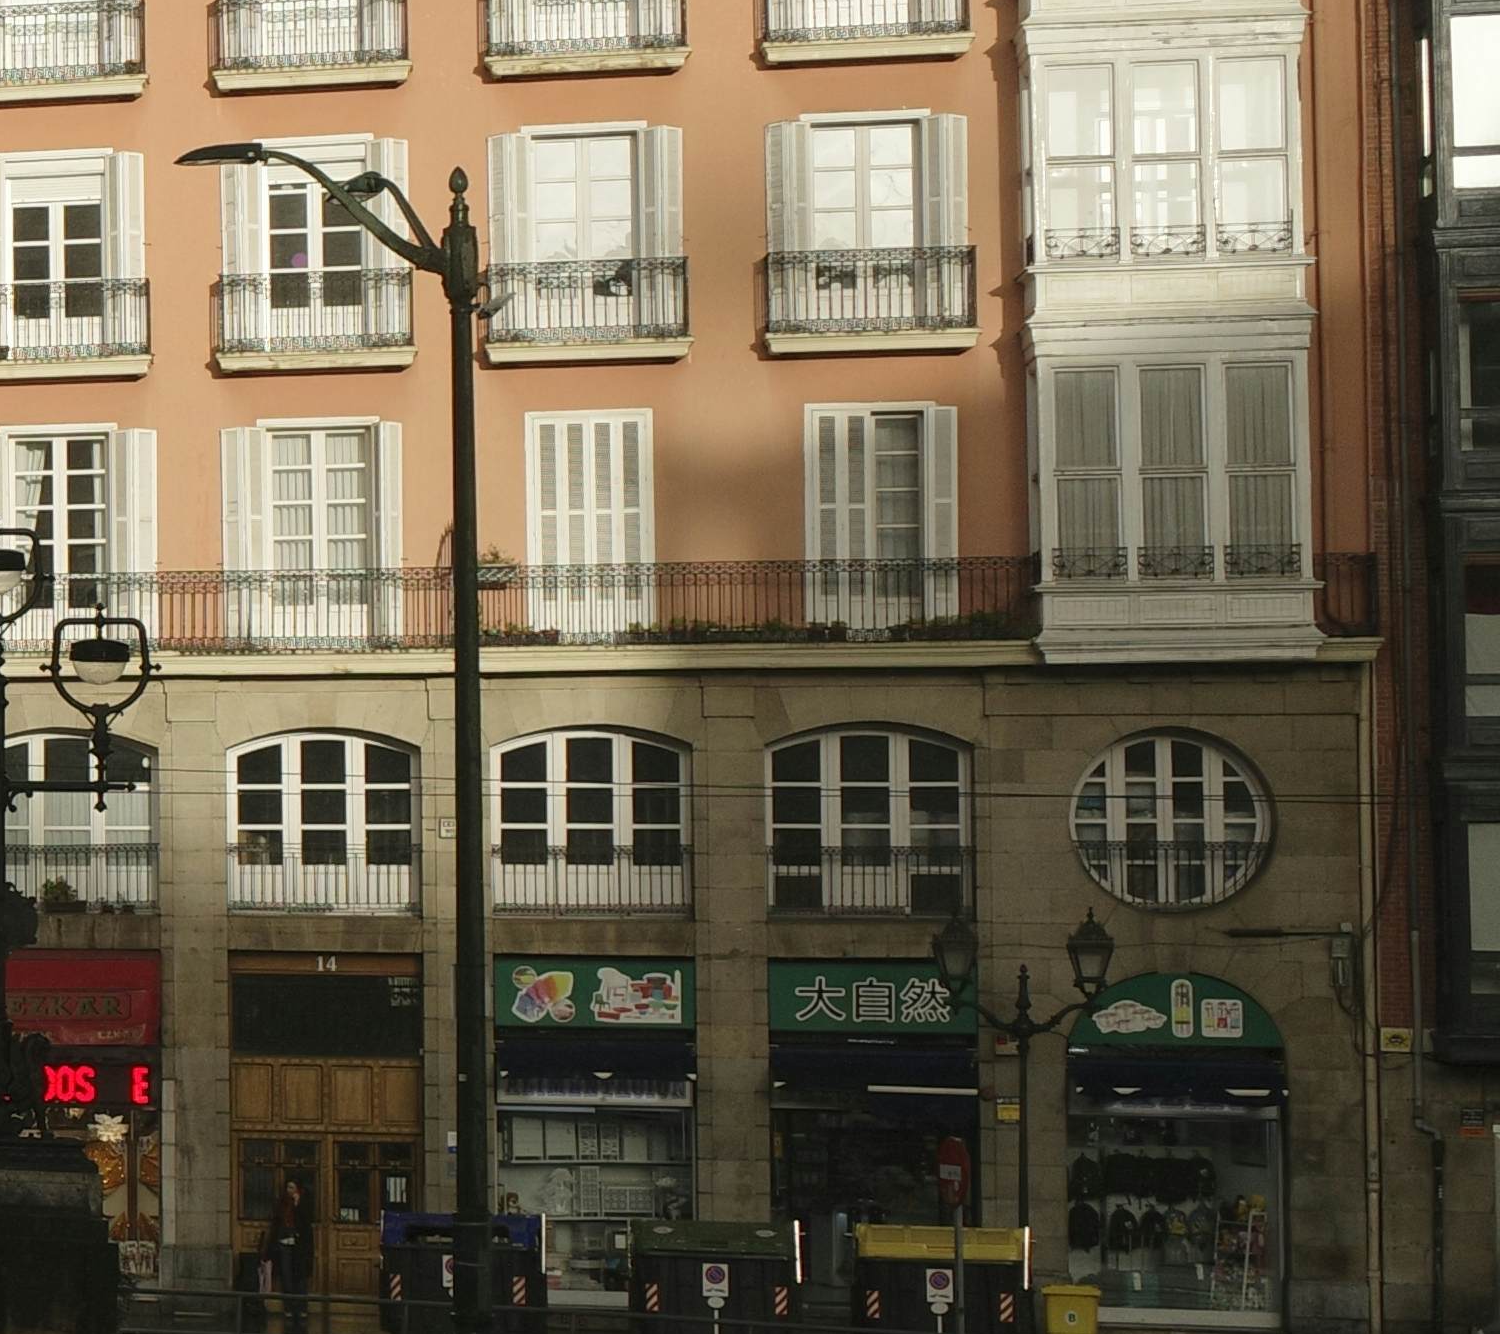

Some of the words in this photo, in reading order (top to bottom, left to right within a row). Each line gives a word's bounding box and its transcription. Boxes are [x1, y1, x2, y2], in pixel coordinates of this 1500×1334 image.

[316, 956, 338, 972] 14
[794, 975, 950, 1023] 大自然
